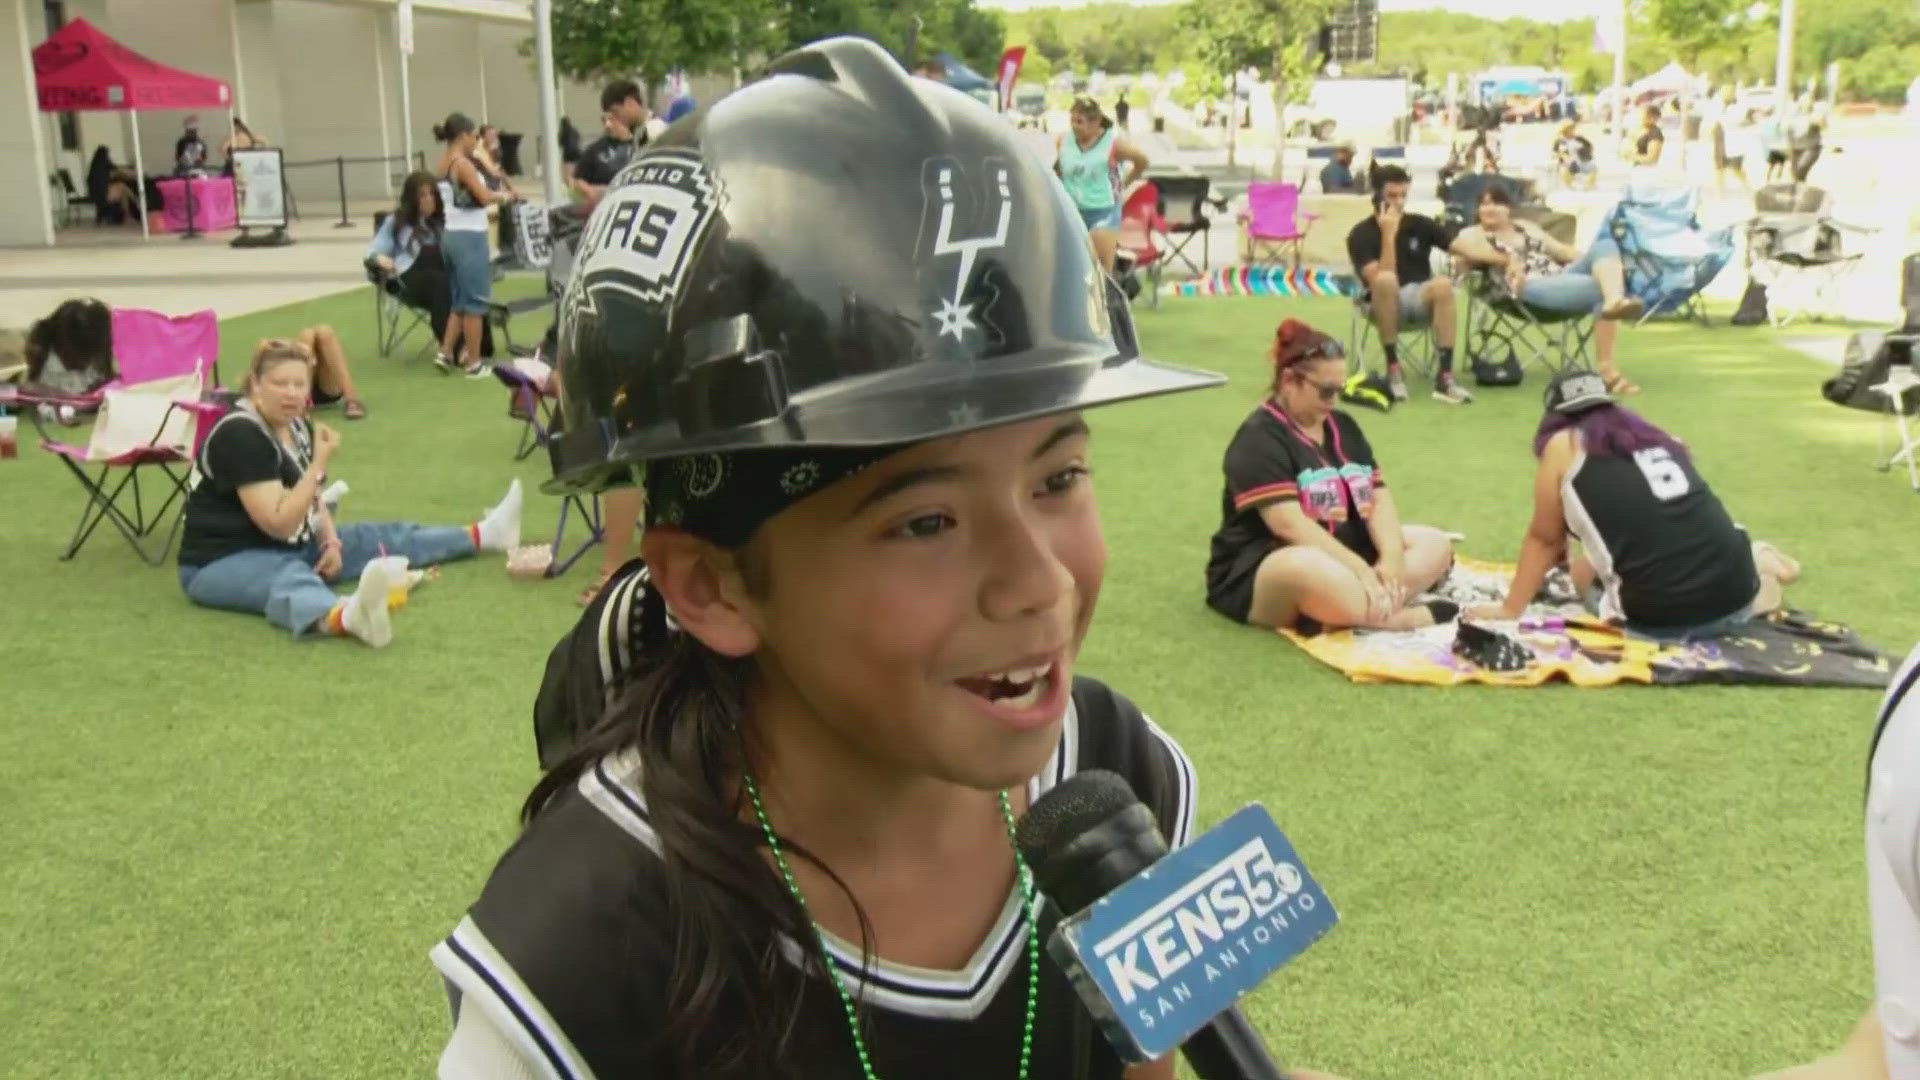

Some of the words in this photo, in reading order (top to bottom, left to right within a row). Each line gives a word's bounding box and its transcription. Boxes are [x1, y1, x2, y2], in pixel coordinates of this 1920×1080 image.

[1632, 446, 1690, 503] 6
[1139, 982, 1191, 1029] SAN
[1203, 893, 1316, 983] ANTONIO
